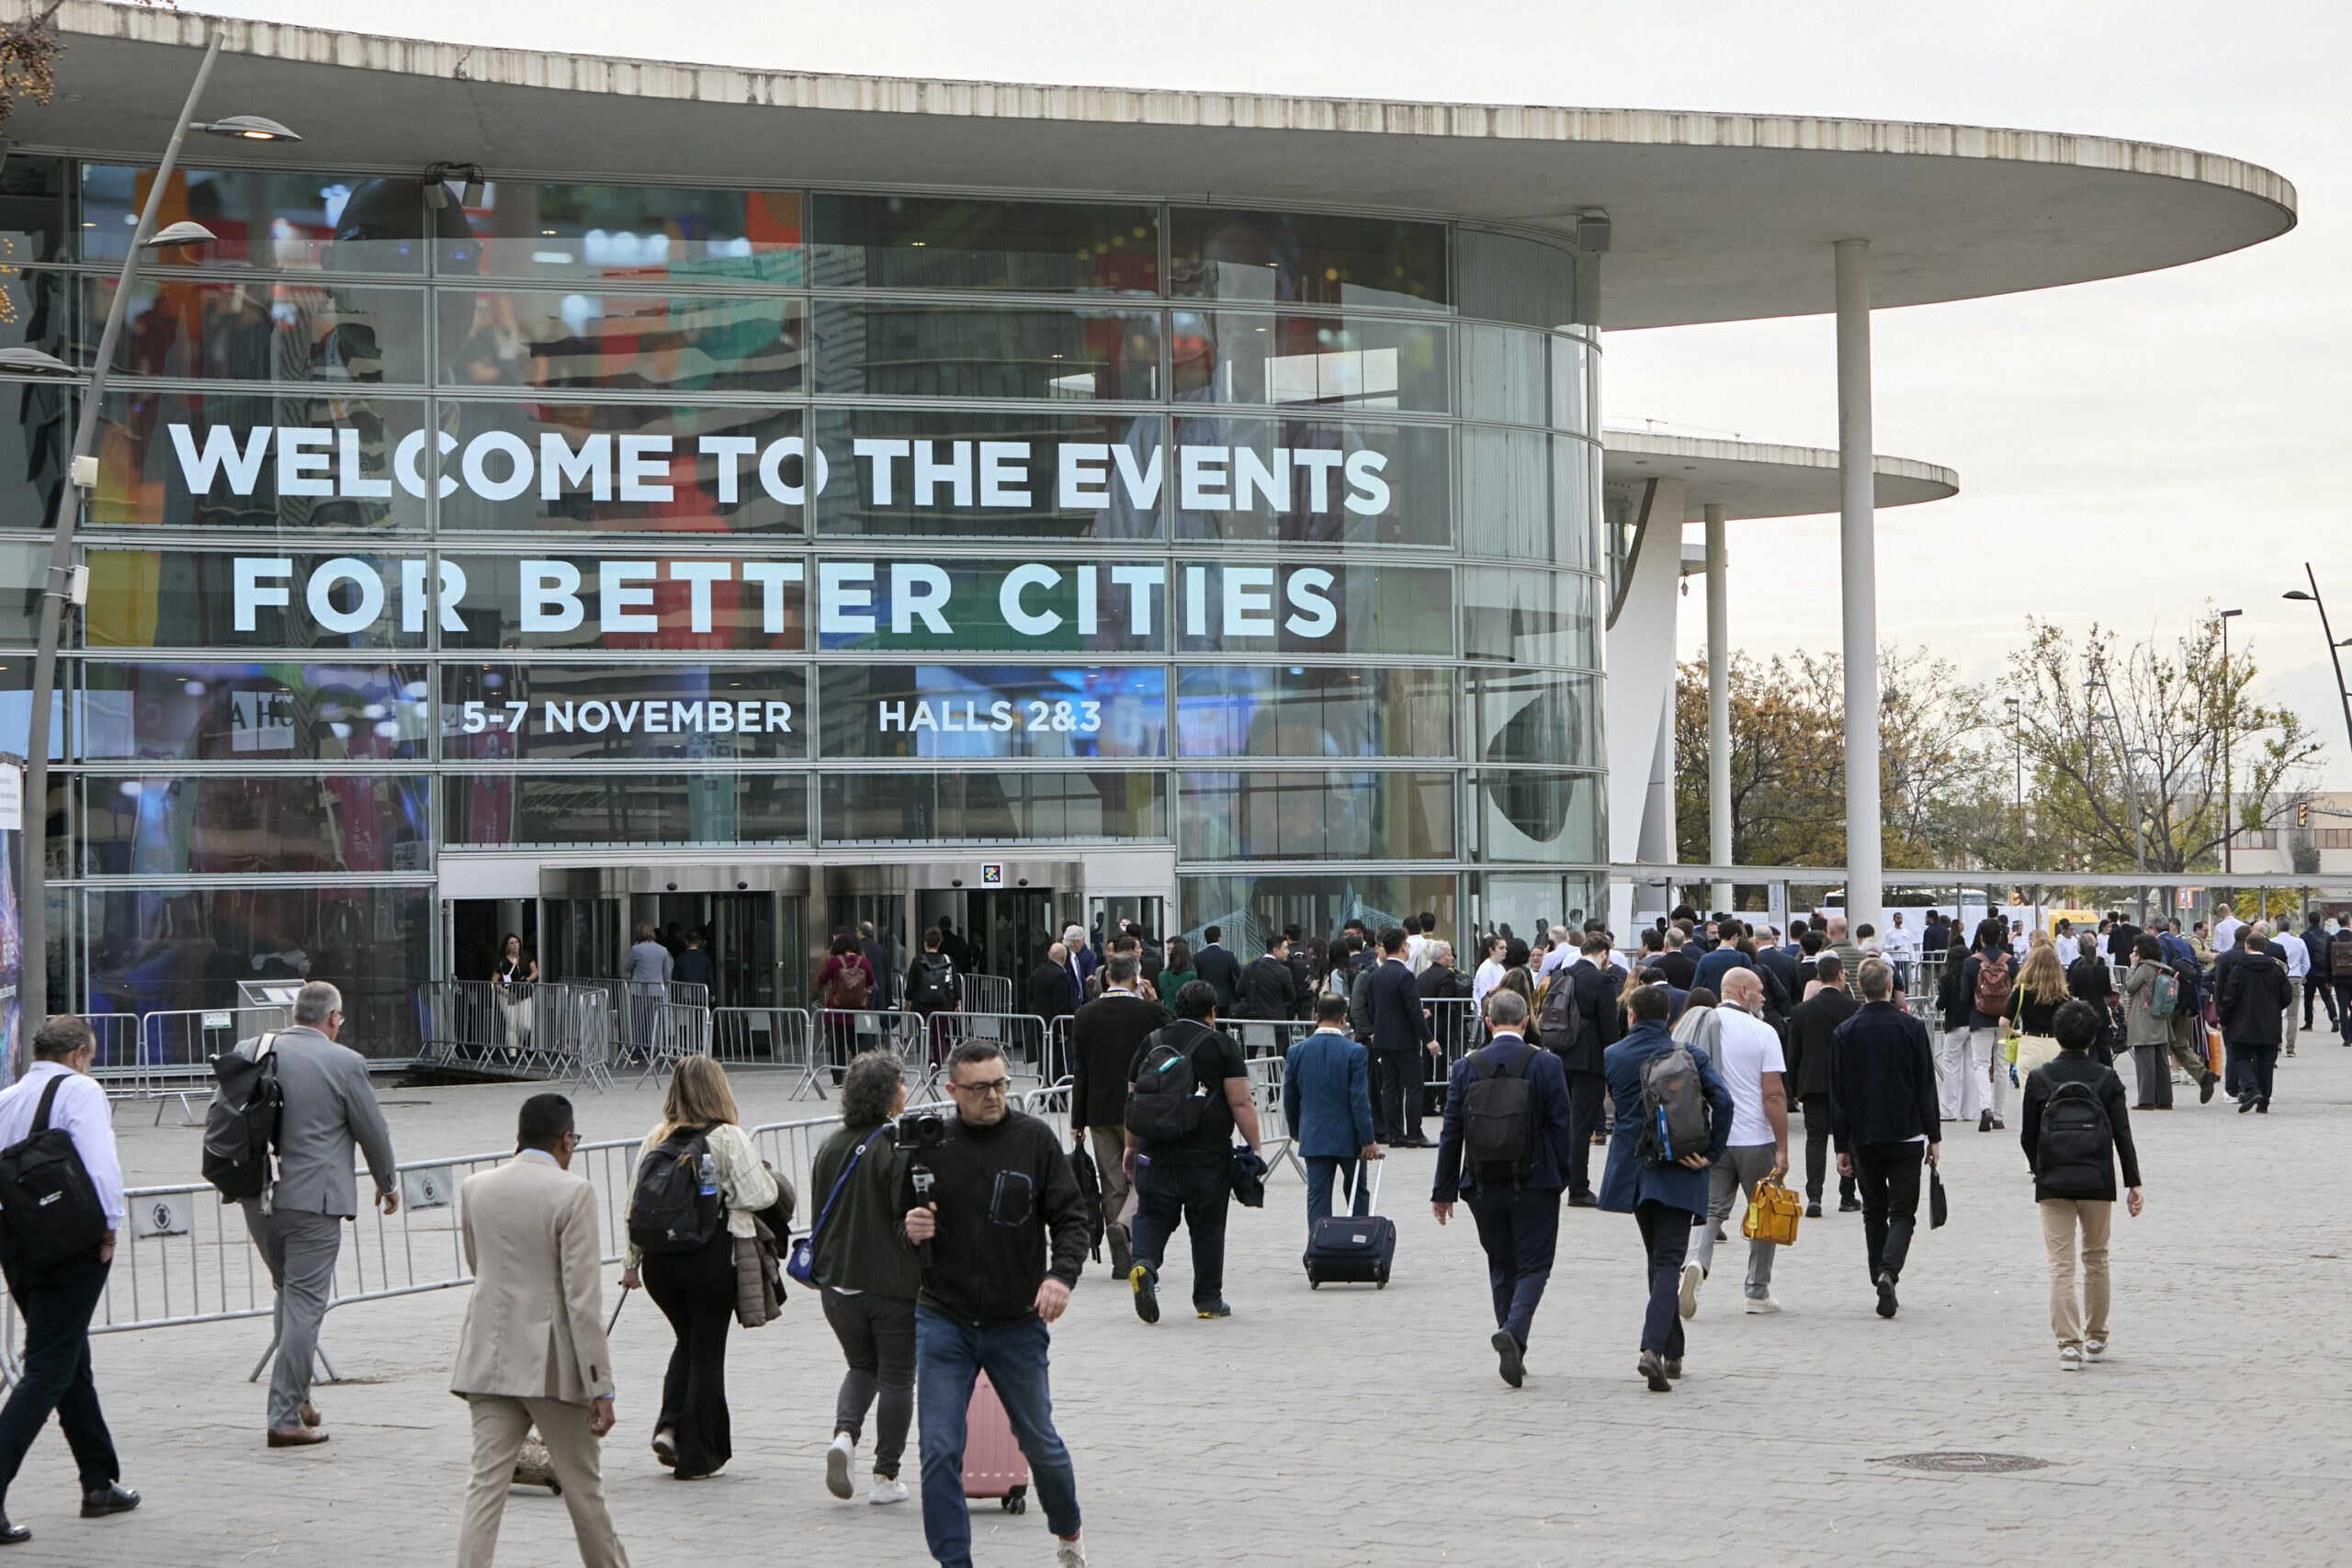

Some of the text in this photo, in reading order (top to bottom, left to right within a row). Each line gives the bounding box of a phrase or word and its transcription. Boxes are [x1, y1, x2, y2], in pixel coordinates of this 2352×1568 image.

[168, 423, 1390, 516] WELCOME TO THE EVENTS
[233, 558, 1338, 638] FOR BETTER CITIES
[462, 700, 792, 733] 5-7 NOVEMBER
[879, 700, 1102, 732] HALLS 2&3
